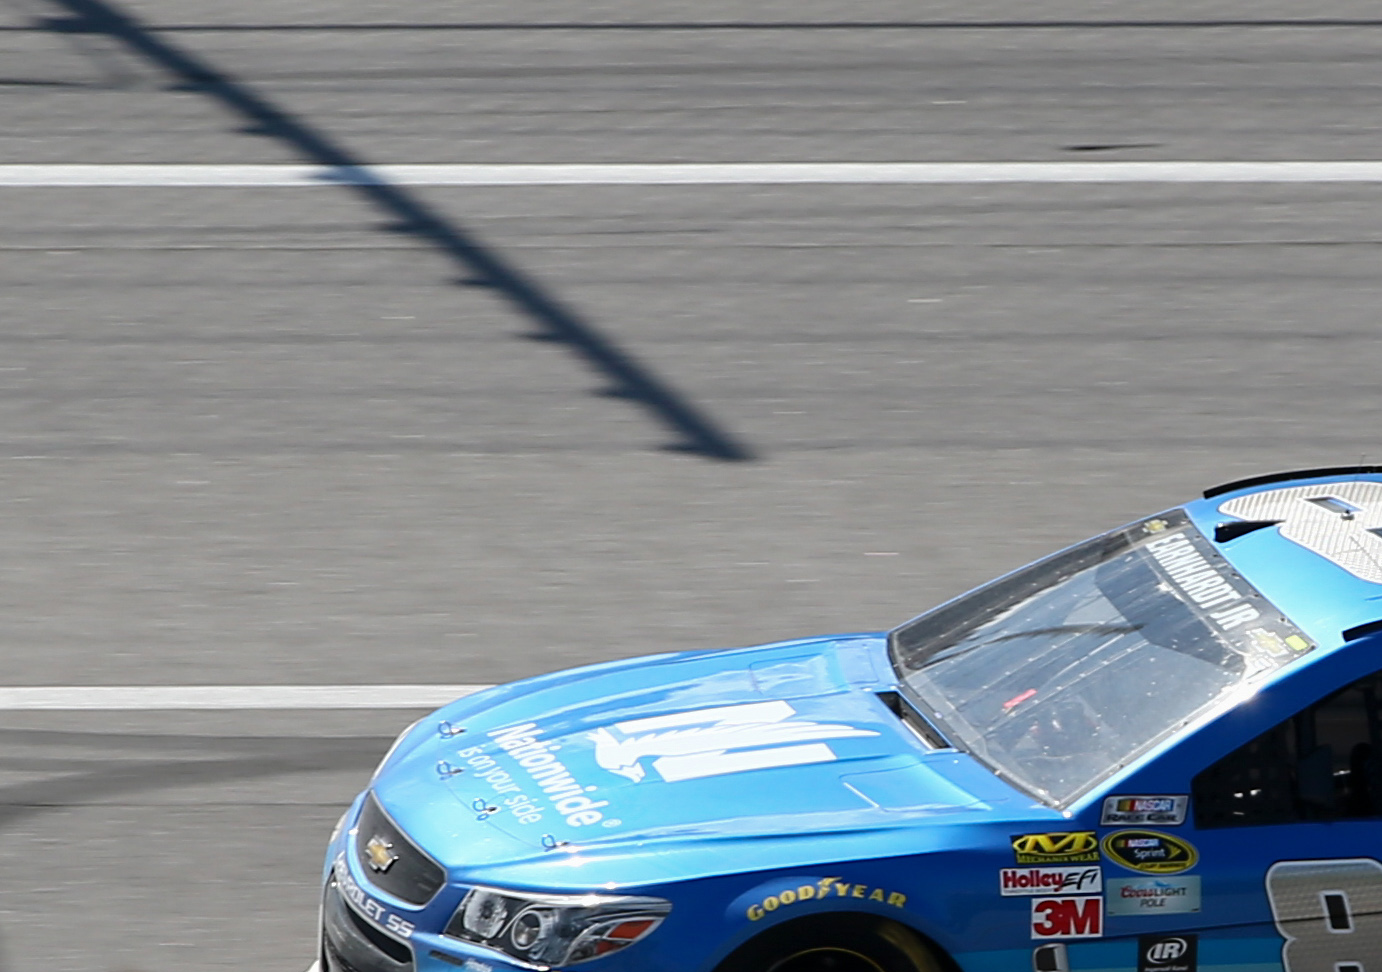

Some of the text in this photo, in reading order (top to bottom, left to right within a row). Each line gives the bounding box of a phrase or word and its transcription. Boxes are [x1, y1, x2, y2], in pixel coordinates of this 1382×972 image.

[1145, 532, 1260, 631] EARNHARDT JR
[457, 744, 545, 825] is on your side
[487, 723, 609, 827] Nationwide
[1135, 799, 1172, 811] NASCAR
[1107, 814, 1145, 822] RACE
[1134, 848, 1166, 859] Sprint
[1003, 870, 1063, 892] Holley
[1154, 886, 1186, 897] LIGHT
[1140, 898, 1166, 907] POLE
[386, 914, 415, 938] SS
[1033, 899, 1100, 936] 3M
[1153, 943, 1181, 959] IR
